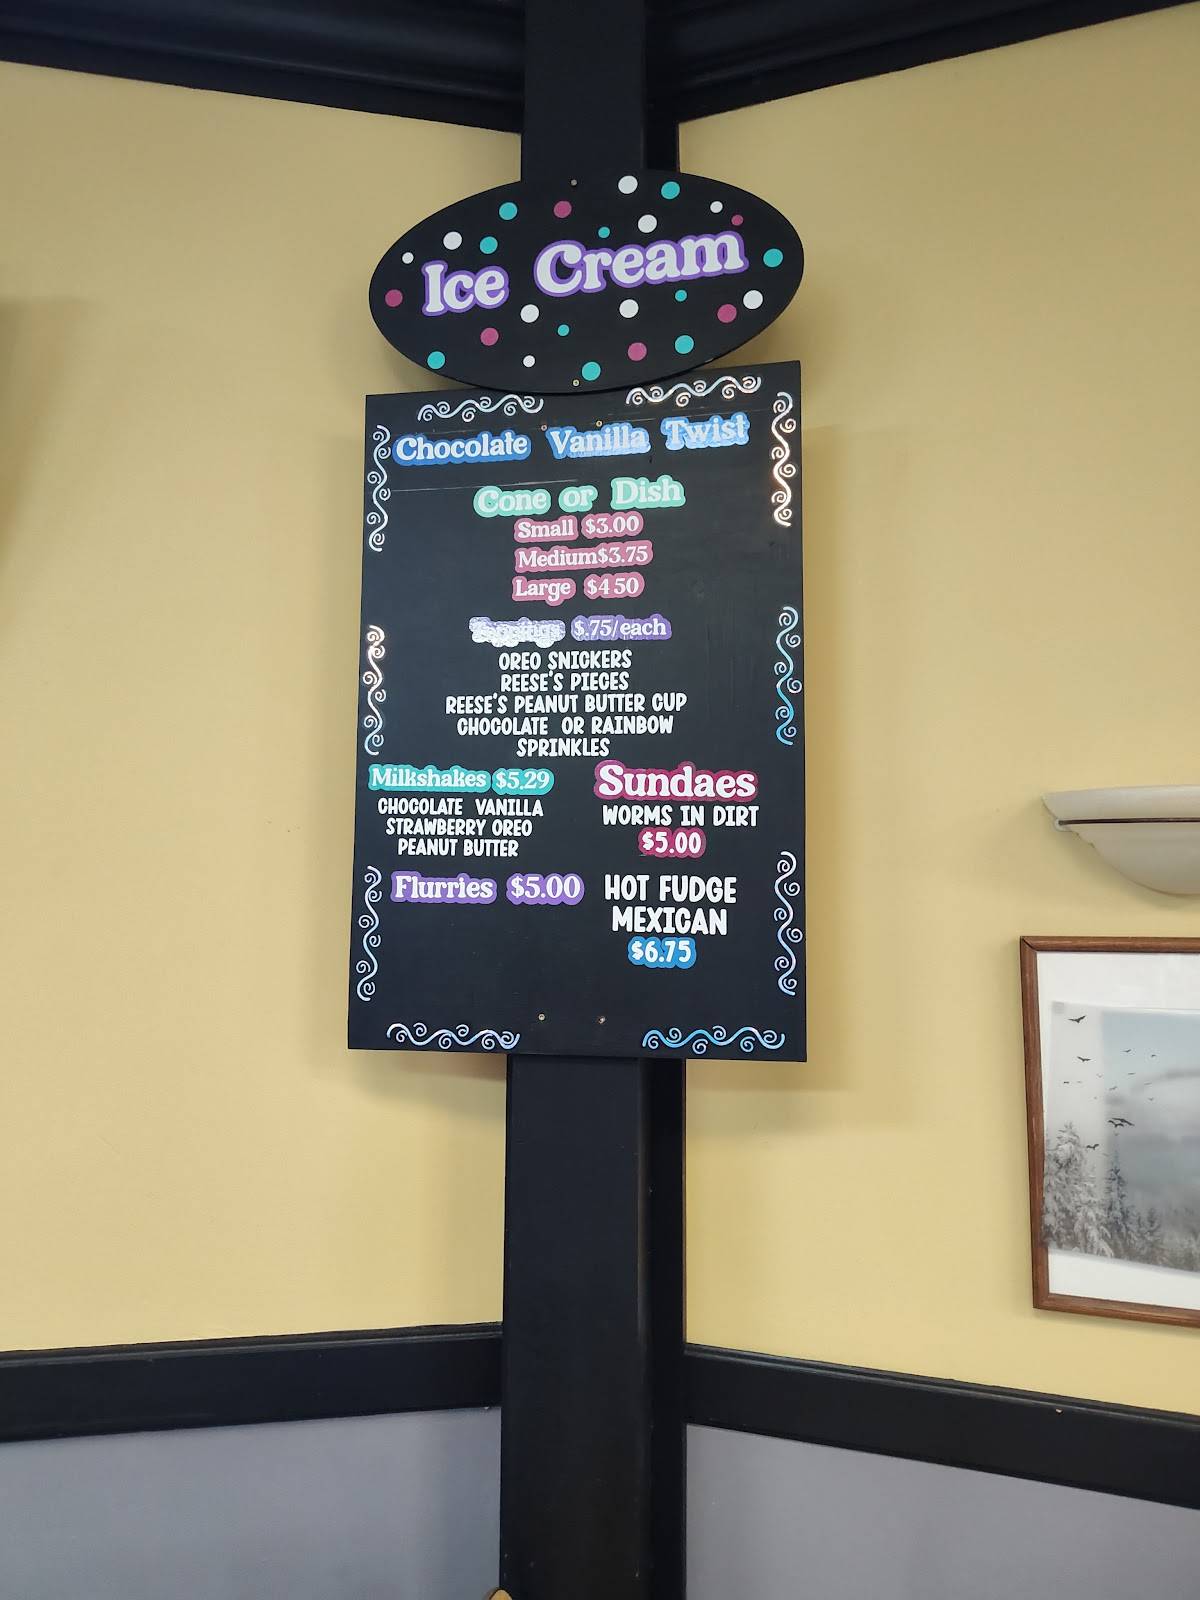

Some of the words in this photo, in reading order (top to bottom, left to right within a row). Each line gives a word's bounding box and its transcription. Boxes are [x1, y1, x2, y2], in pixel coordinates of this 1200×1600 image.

[425, 264, 505, 313] Ice
[535, 233, 746, 296] Cream
[395, 430, 529, 462] Chocolate
[549, 424, 650, 456] Vanilla
[665, 412, 749, 445] Twist
[476, 490, 549, 514] Cone
[562, 487, 595, 507] or
[614, 477, 683, 505] Dish
[516, 519, 575, 540] Small
[584, 515, 641, 535] $3.00
[514, 579, 572, 602] Large
[498, 651, 542, 671] OREO
[546, 649, 633, 669] SNICKERS
[500, 667, 564, 693] REESE'S
[569, 671, 630, 691] PIECES
[445, 692, 508, 715] REESE'S
[513, 693, 579, 714] PEANUT
[583, 692, 646, 713] BUTTER
[651, 692, 688, 712] CUP
[456, 716, 549, 736] CHOCOLATE
[561, 716, 585, 735] OR
[591, 714, 674, 735] RAINBOW
[515, 736, 612, 758] SPRINKLES
[370, 767, 488, 788] Milkshakes
[494, 770, 551, 790] $5.29
[598, 764, 756, 798] Sundaes
[377, 797, 464, 816] CHOCOLATE
[474, 798, 544, 817] VANILLA
[602, 804, 673, 826] WORMS
[679, 805, 705, 827] IN
[712, 805, 760, 827] DIRT
[385, 817, 487, 836] STRAWBERRY
[491, 818, 533, 837] OREO
[397, 837, 459, 856] PEANUT
[463, 838, 519, 857] BUTTER
[642, 831, 702, 854] $5.00
[395, 875, 493, 899] Flurries
[511, 875, 581, 899] $5.00
[604, 874, 650, 901] HOT
[658, 875, 738, 905] FUDGE
[611, 905, 729, 936] MEXICAN
[631, 940, 691, 963] $6.75
